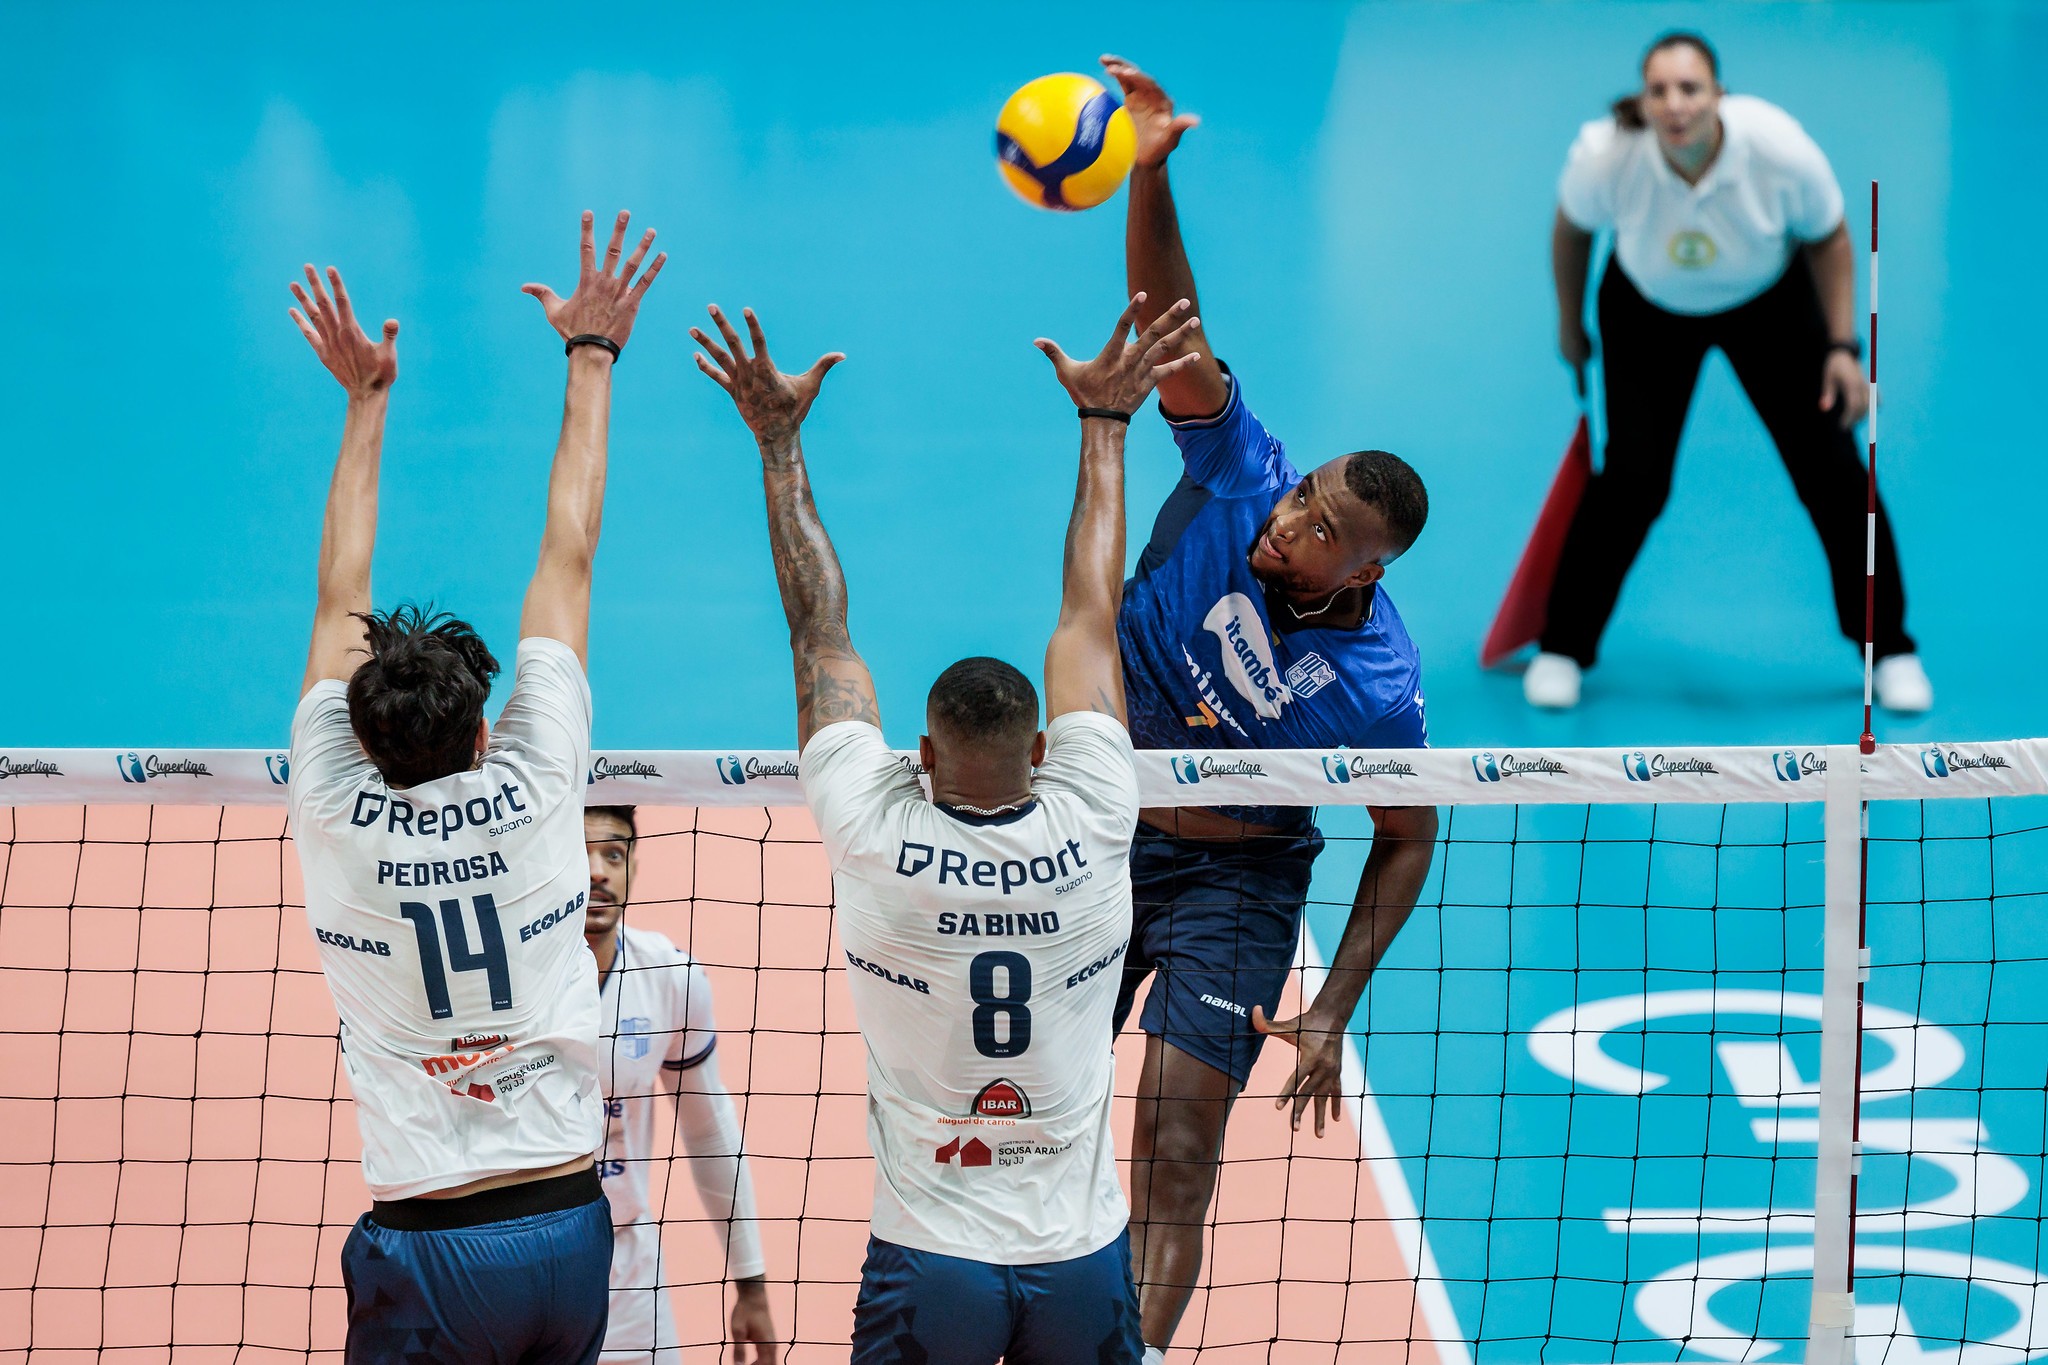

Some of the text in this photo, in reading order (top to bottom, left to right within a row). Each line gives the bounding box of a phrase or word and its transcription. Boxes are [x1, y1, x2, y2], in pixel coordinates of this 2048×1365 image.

[1225, 615, 1283, 703] itambé
[145, 755, 214, 779] Superliga
[594, 757, 662, 780] Superliga
[745, 756, 799, 780] Superlig
[1200, 755, 1268, 779] Superliga
[1350, 755, 1418, 779] Superliga
[1500, 753, 1569, 777] Superliga
[1651, 753, 1719, 777] Superliga
[1947, 751, 2012, 772] Superliga
[388, 782, 526, 841] Report
[489, 815, 533, 837] suzano
[378, 851, 509, 886] PEDROSA
[939, 838, 1087, 895] Report
[1055, 871, 1093, 896] suzano
[520, 891, 585, 943] ECOLAB
[936, 911, 1060, 936] SABINO
[315, 928, 391, 956] ECOLAB
[400, 893, 513, 1020] 14
[845, 949, 930, 994] ECOLAB
[969, 950, 1032, 1059] 8
[982, 1100, 1017, 1109] IBAR
[937, 1117, 1016, 1126] aluguel de carros
[998, 1146, 1032, 1156] SOUSA
[998, 1156, 1024, 1167] by JJ
